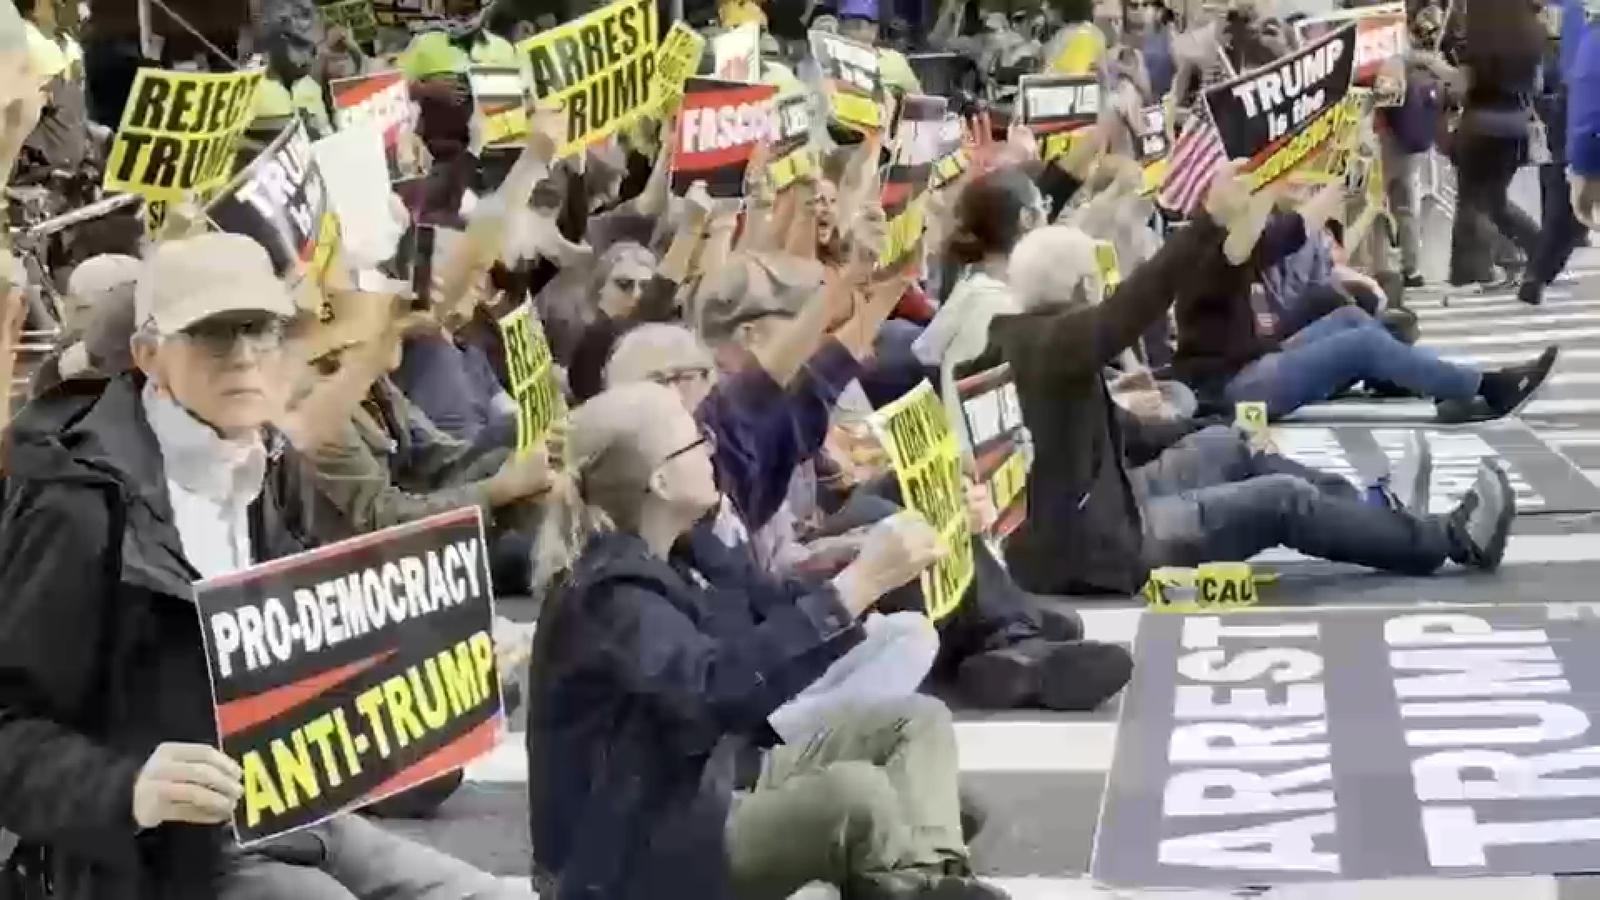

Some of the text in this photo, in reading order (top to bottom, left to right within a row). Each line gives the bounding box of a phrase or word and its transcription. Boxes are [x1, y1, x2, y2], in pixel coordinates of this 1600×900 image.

[528, 0, 652, 98] ARREST
[561, 52, 655, 142] RUMP
[1232, 38, 1345, 117] TRUMP
[210, 538, 481, 679] PRO-DEMOCRACY
[241, 630, 495, 827] ANTI-TRUMP
[1158, 615, 1341, 874] ARREST
[1384, 613, 1600, 867] TRUMP
